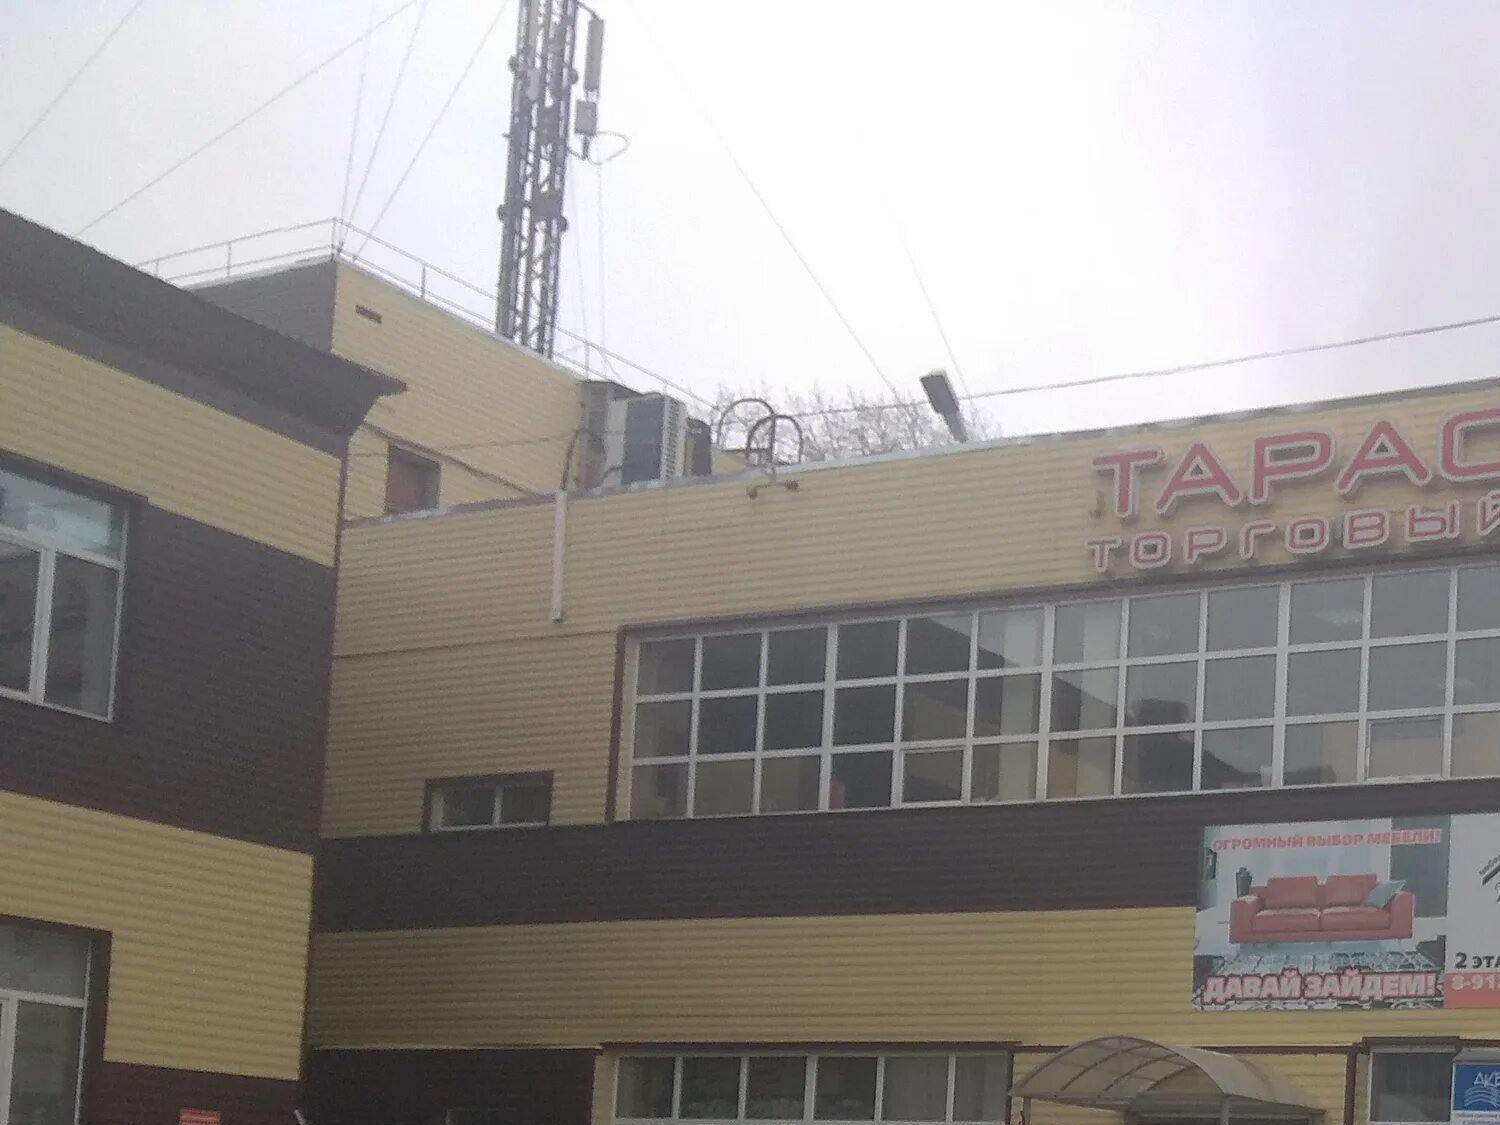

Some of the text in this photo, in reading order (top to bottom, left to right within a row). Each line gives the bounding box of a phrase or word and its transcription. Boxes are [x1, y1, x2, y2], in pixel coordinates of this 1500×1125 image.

[1212, 837, 1303, 851] ОГРОМНЫЙ
[1306, 833, 1364, 847] ВЫБОР
[1454, 952, 1467, 969] 2
[1203, 968, 1301, 1005] ДАВАЙ
